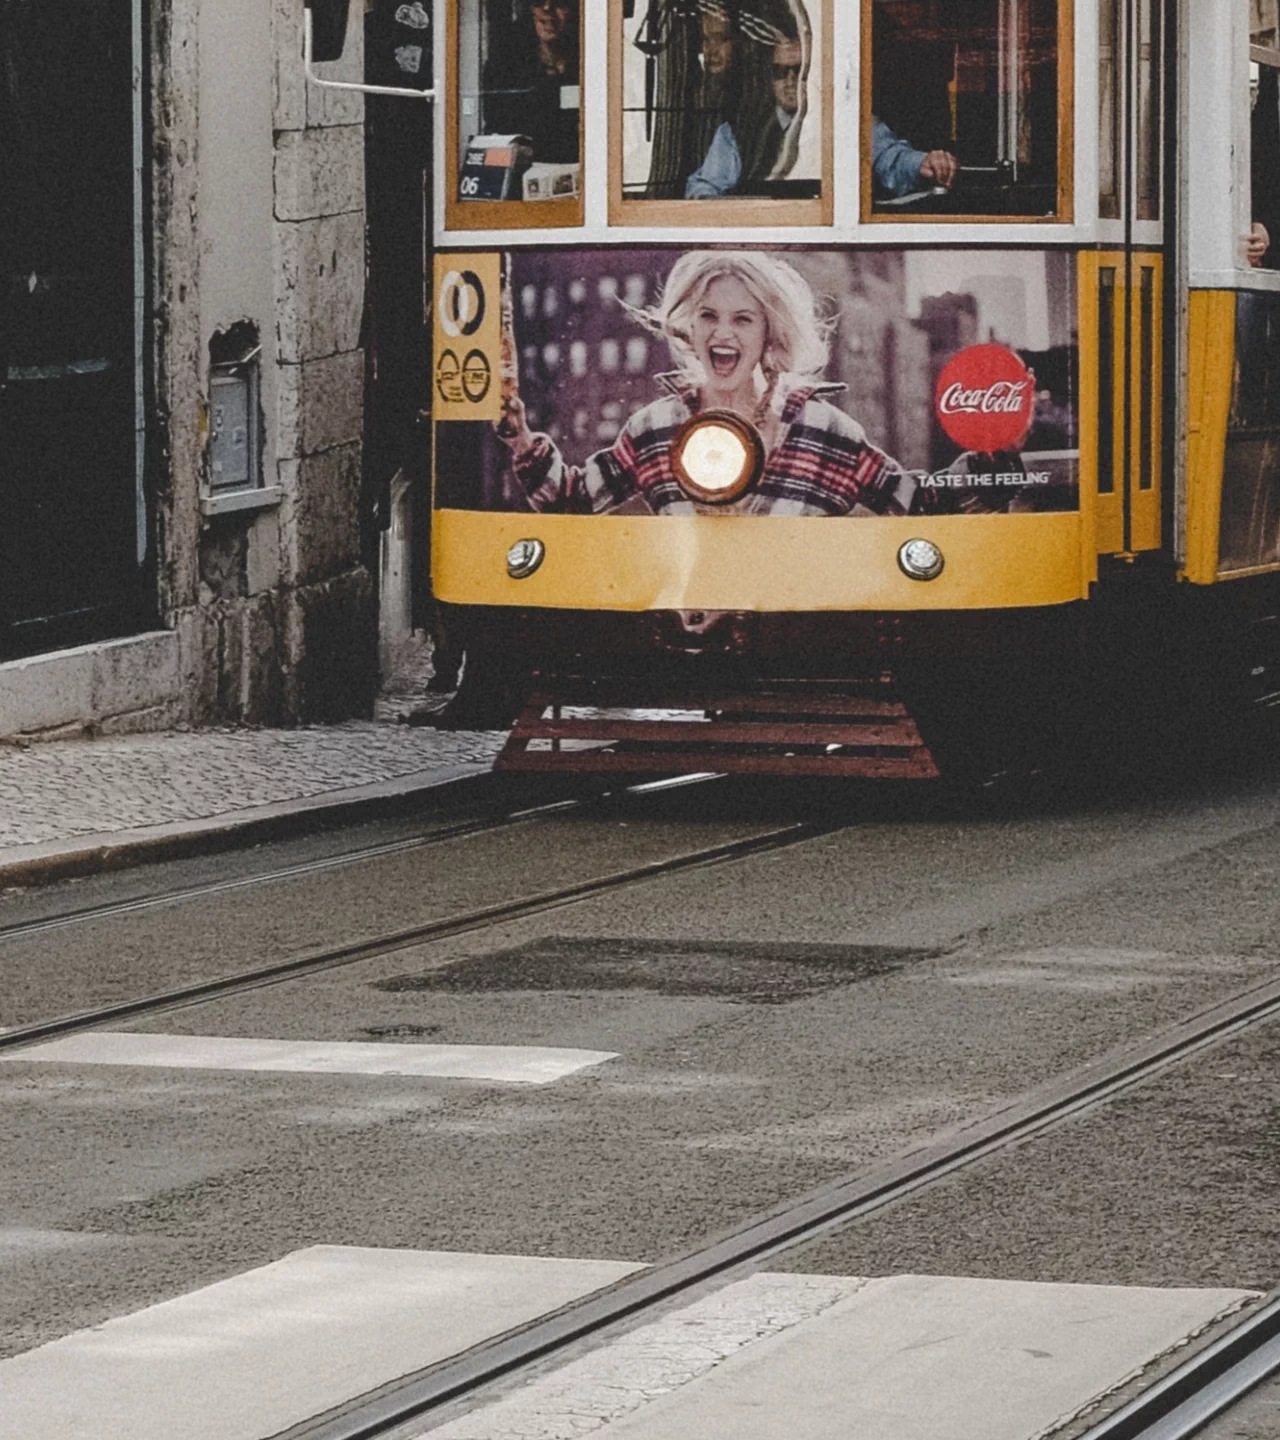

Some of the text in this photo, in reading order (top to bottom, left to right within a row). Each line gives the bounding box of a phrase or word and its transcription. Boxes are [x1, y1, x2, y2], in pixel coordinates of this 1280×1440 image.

[460, 175, 480, 195] 06
[939, 380, 1029, 415] Coca-Cola
[917, 471, 1050, 488] TASTE THE FEELING
